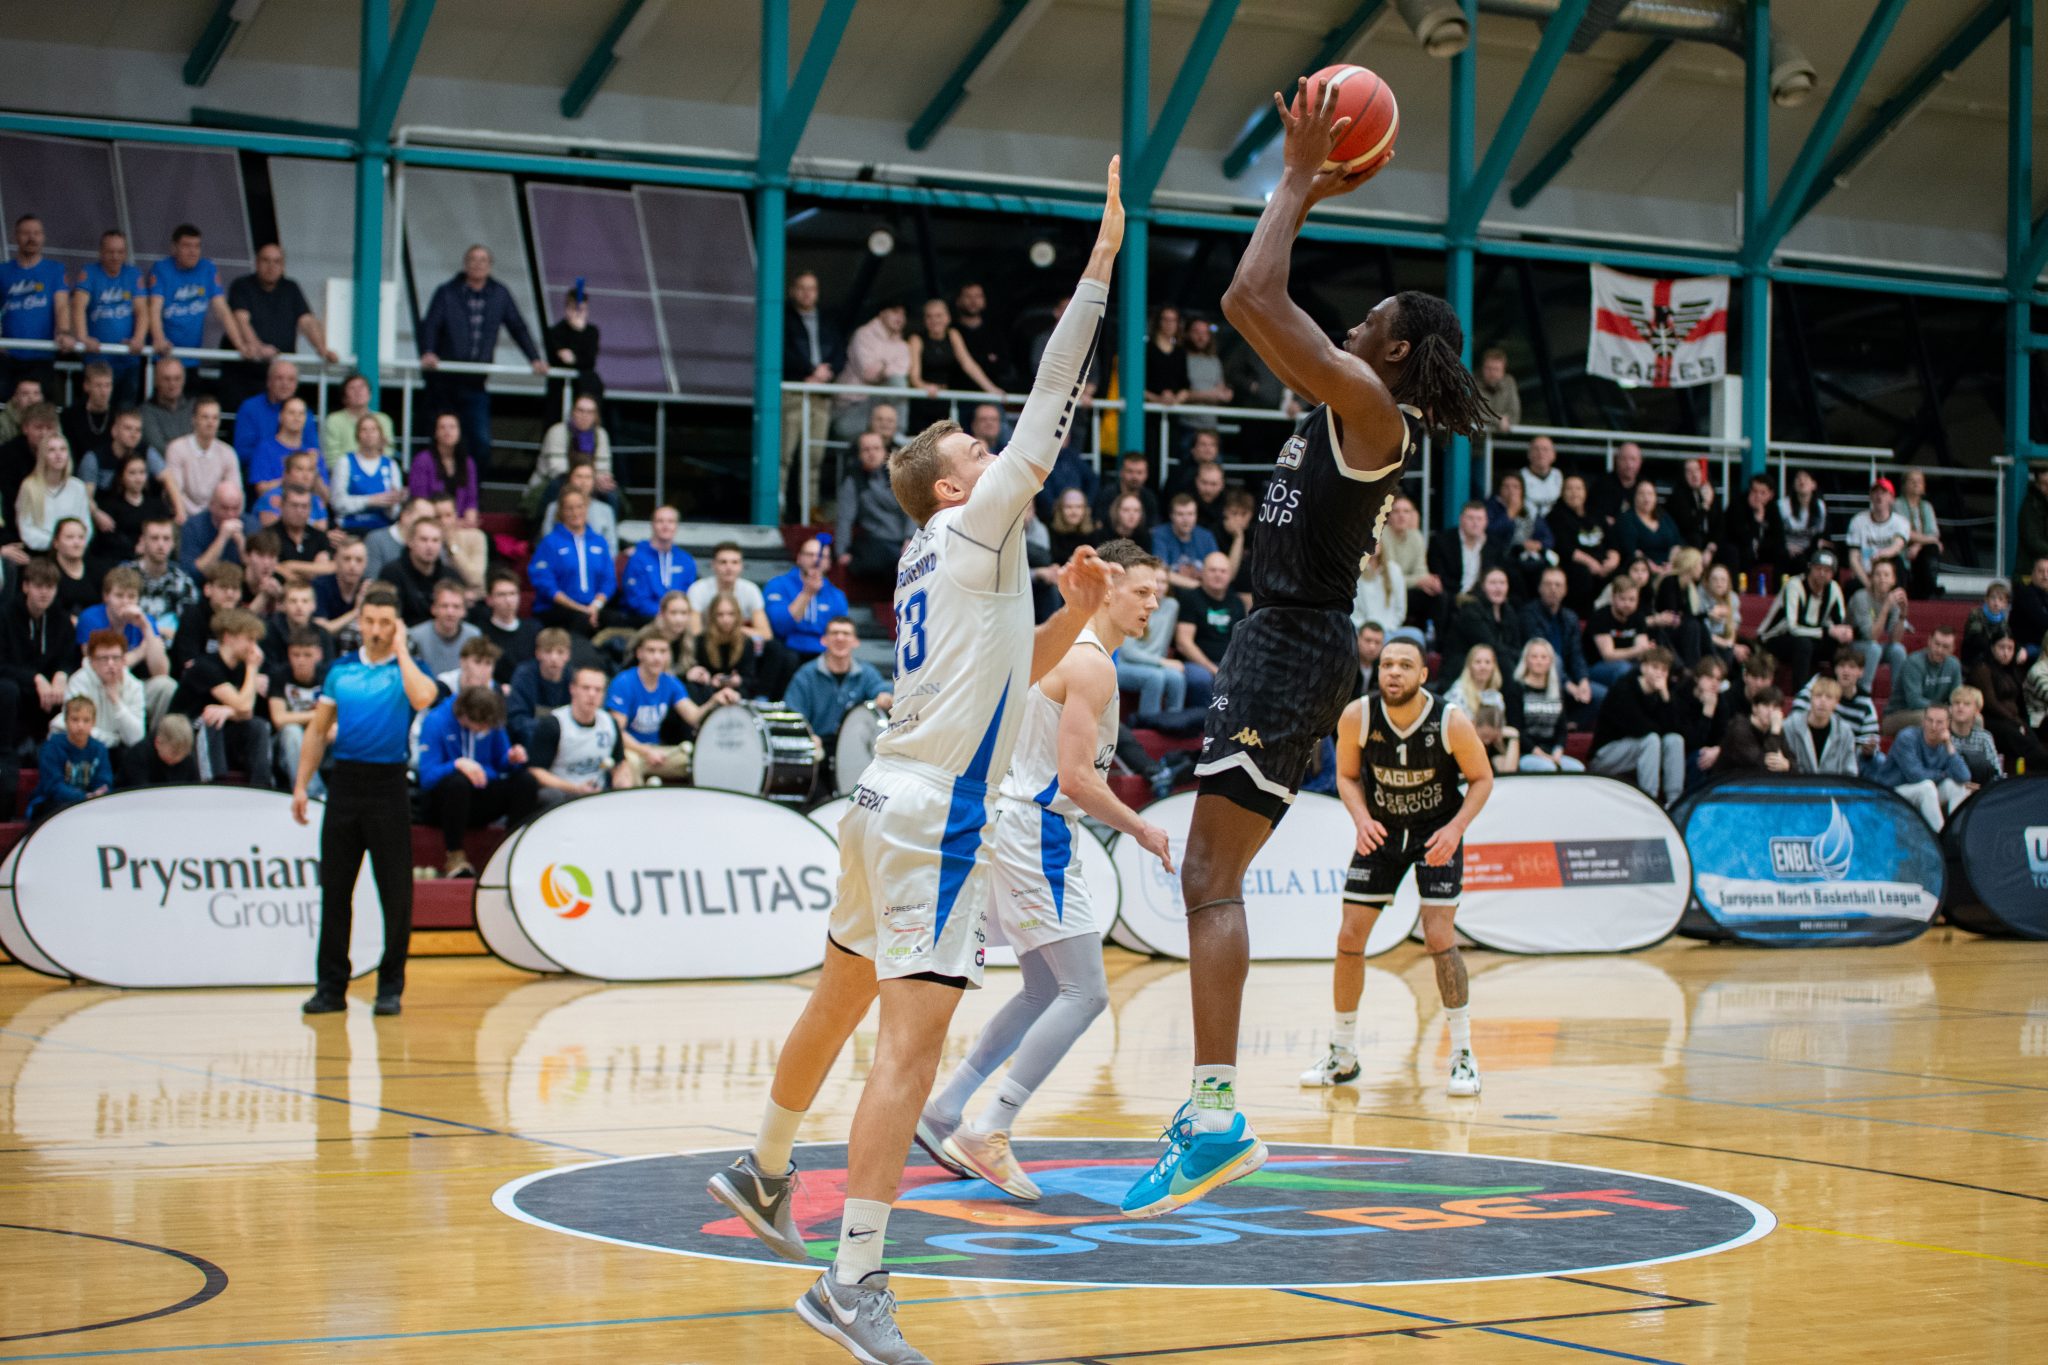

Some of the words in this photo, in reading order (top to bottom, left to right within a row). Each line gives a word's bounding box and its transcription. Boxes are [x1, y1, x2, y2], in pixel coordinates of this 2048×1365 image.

[1610, 355, 1715, 382] EAGLES
[1265, 478, 1302, 508] IÖS
[1258, 503, 1293, 527] OUP
[893, 588, 929, 680] 13
[1396, 743, 1408, 766] 1
[1373, 768, 1436, 787] EAGLES
[1386, 794, 1443, 815] GROUP
[1773, 842, 1813, 873] ENBL
[97, 845, 322, 907] Prysmian
[1243, 869, 1305, 895] EILA
[605, 866, 832, 916] UTILITAS
[1719, 890, 1773, 908] European
[1777, 890, 1811, 905] North
[1815, 889, 1877, 905] Basketball
[1879, 889, 1922, 910] League
[208, 891, 321, 938] Group
[802, 1189, 1692, 1266] COOLBET
